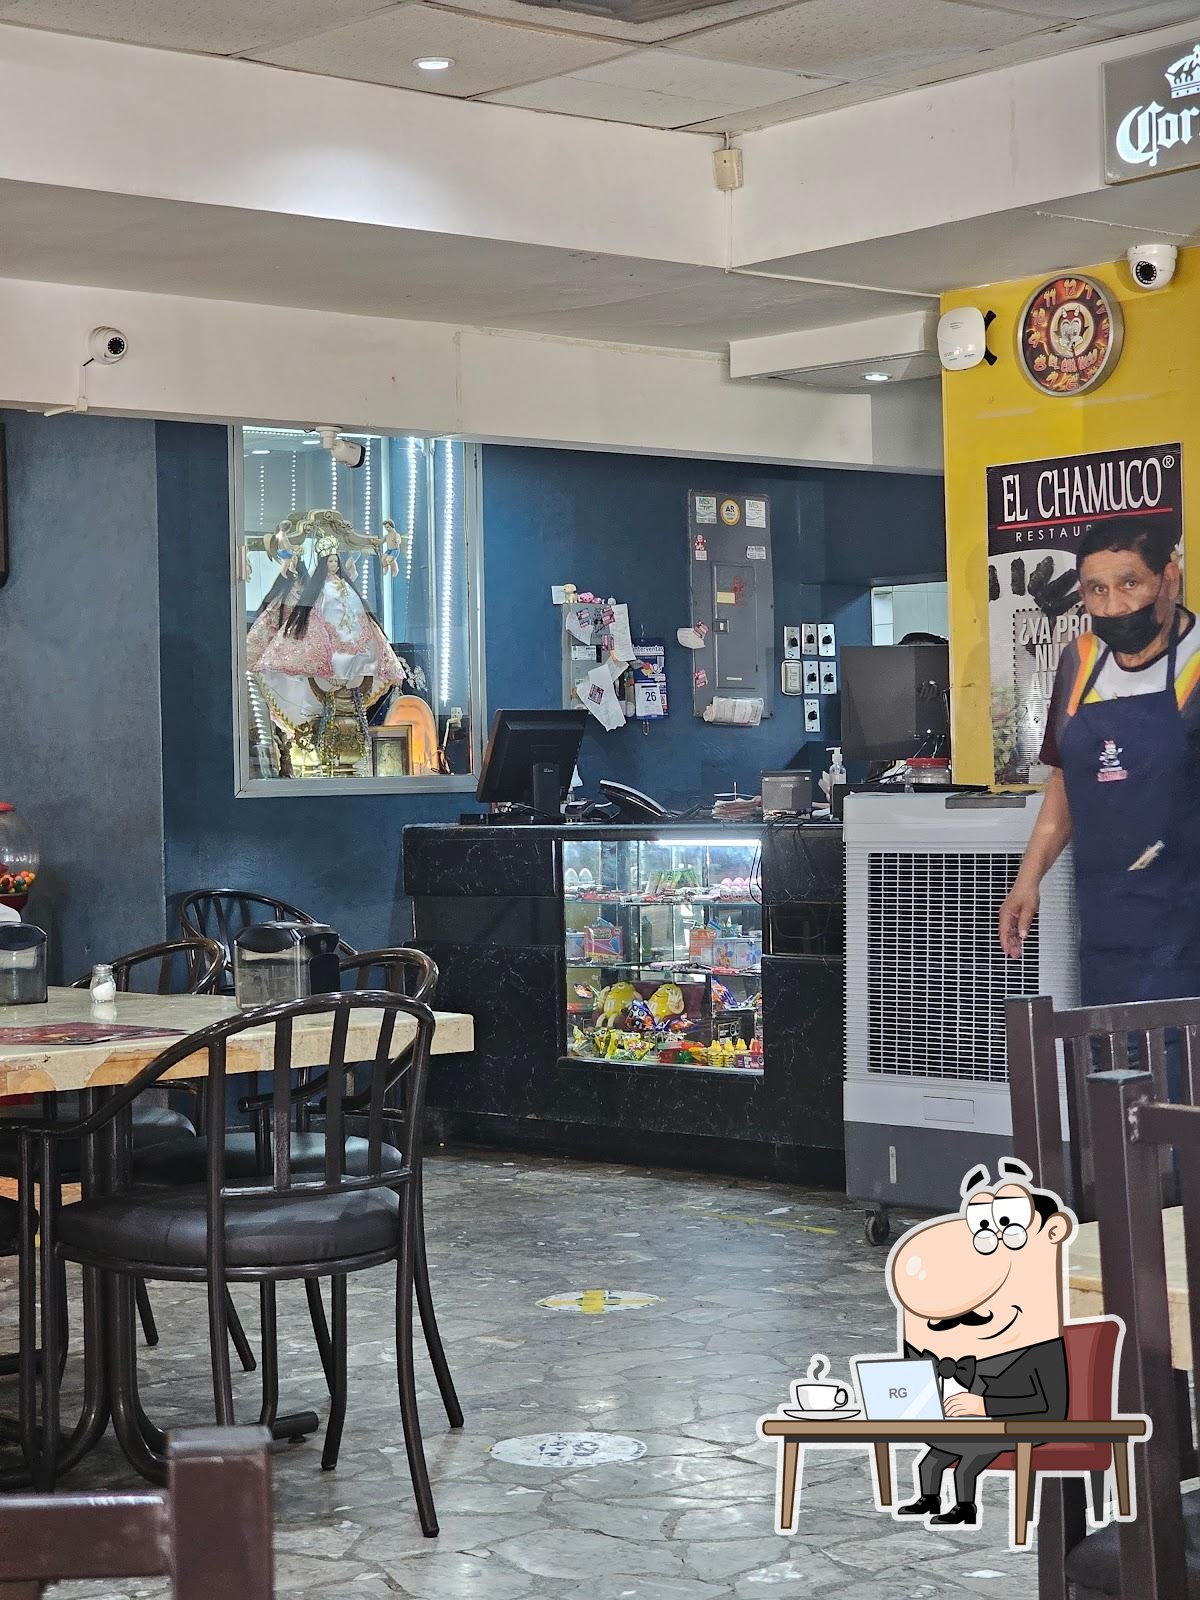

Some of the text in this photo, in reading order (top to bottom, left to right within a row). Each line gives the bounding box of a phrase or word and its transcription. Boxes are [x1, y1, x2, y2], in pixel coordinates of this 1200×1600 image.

[1116, 101, 1200, 167] Cor
[1002, 474, 1028, 522] EL
[1019, 613, 1093, 646] ¿YA PRO
[1035, 644, 1065, 672] NU
[645, 691, 657, 702] 26
